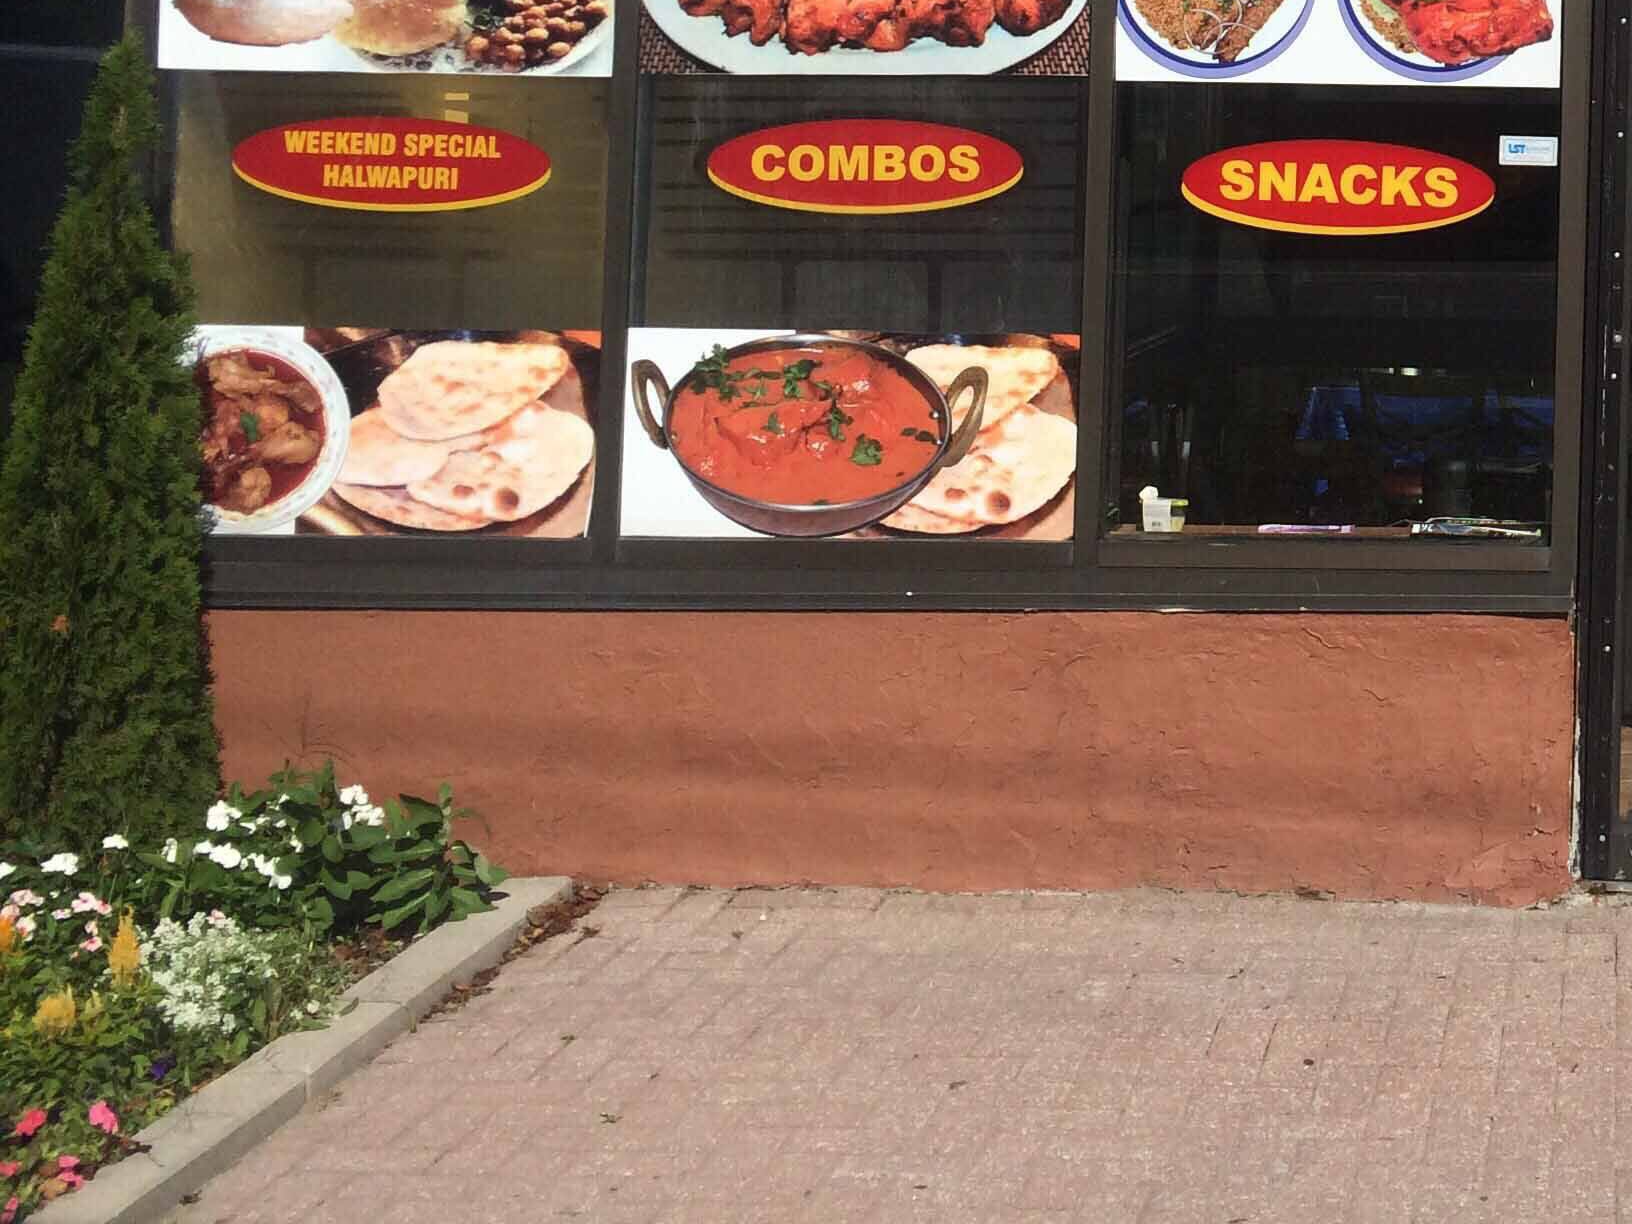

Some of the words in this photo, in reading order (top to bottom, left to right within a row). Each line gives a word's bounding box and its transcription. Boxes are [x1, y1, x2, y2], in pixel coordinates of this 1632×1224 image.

[284, 130, 397, 156] WEEKEND
[403, 132, 501, 159] SPECIAL
[323, 164, 459, 191] HALWAPURI
[751, 144, 980, 182] COMBOS
[1219, 159, 1459, 208] SNACKS
